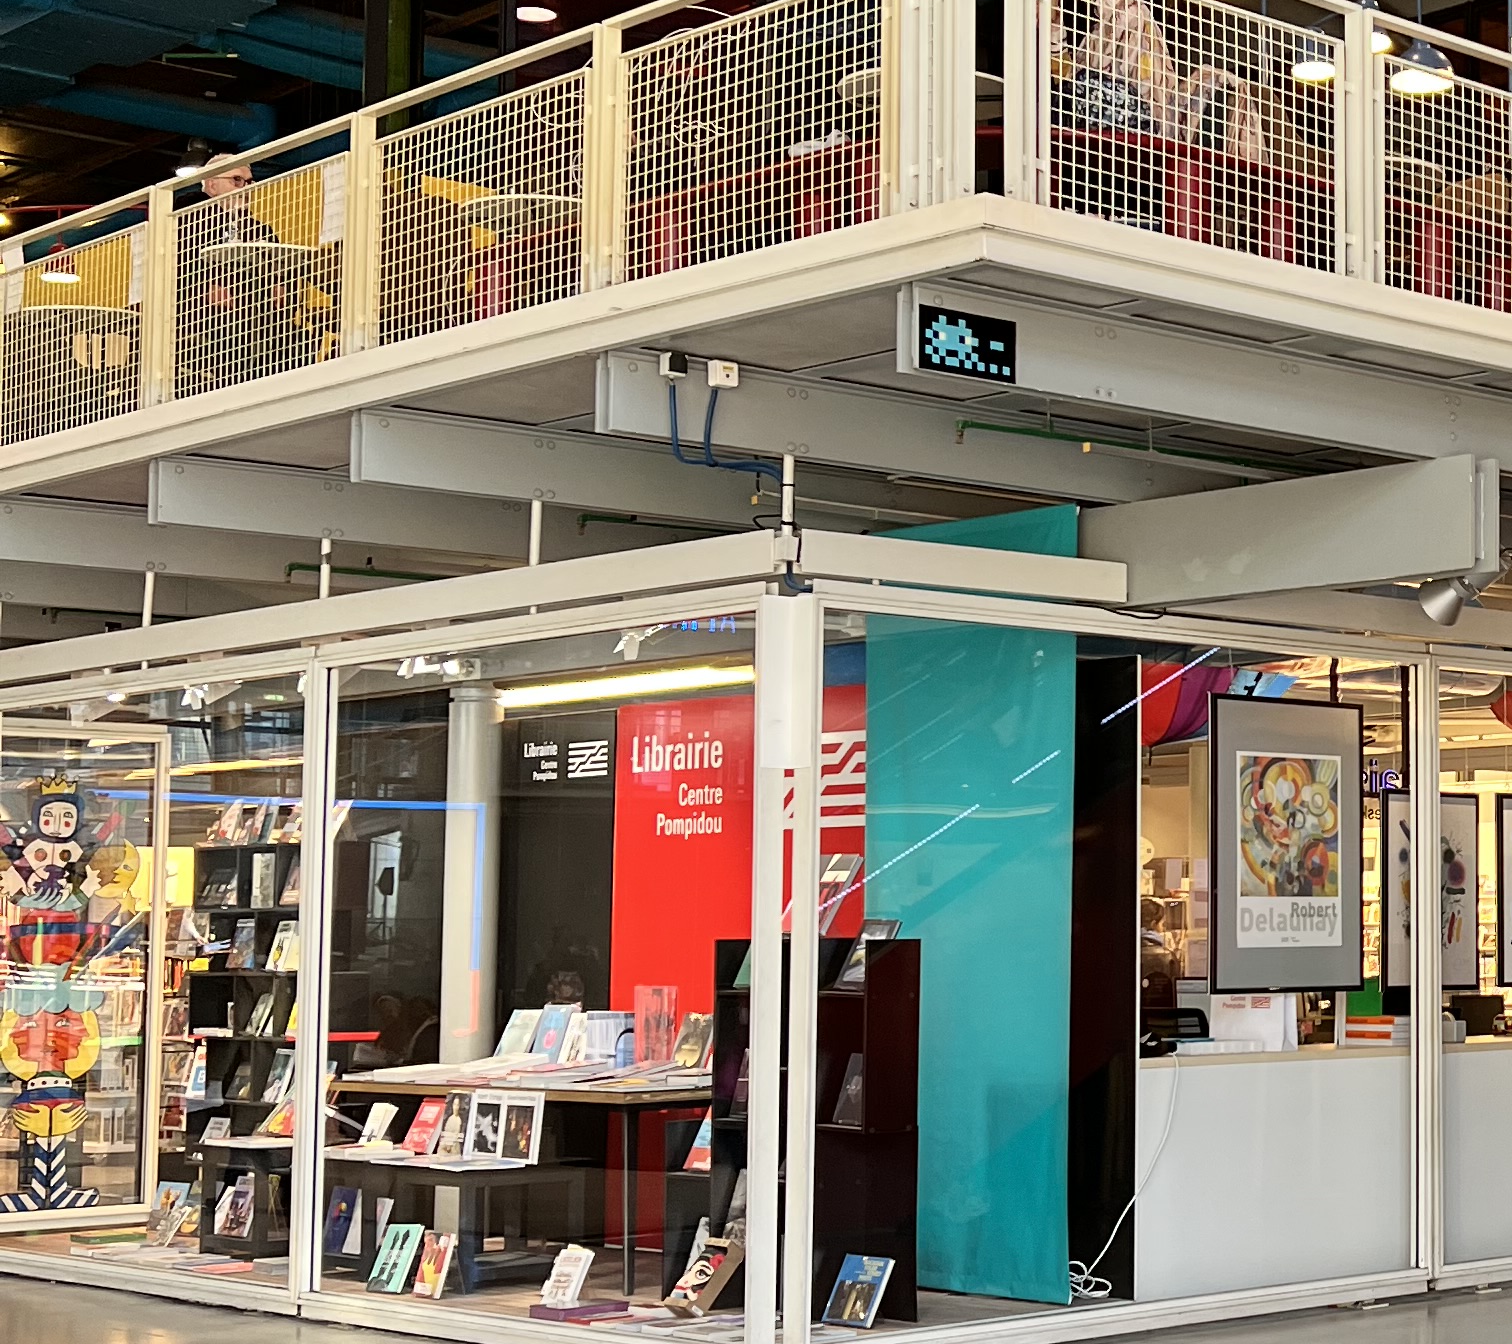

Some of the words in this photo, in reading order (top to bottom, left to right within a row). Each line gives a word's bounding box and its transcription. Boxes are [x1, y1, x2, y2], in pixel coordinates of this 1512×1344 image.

[632, 731, 723, 774] Librairie
[678, 782, 723, 806] Centre
[656, 811, 723, 840] Pompidou
[1240, 907, 1338, 937] Delaunay
[1290, 901, 1337, 918] Robert
